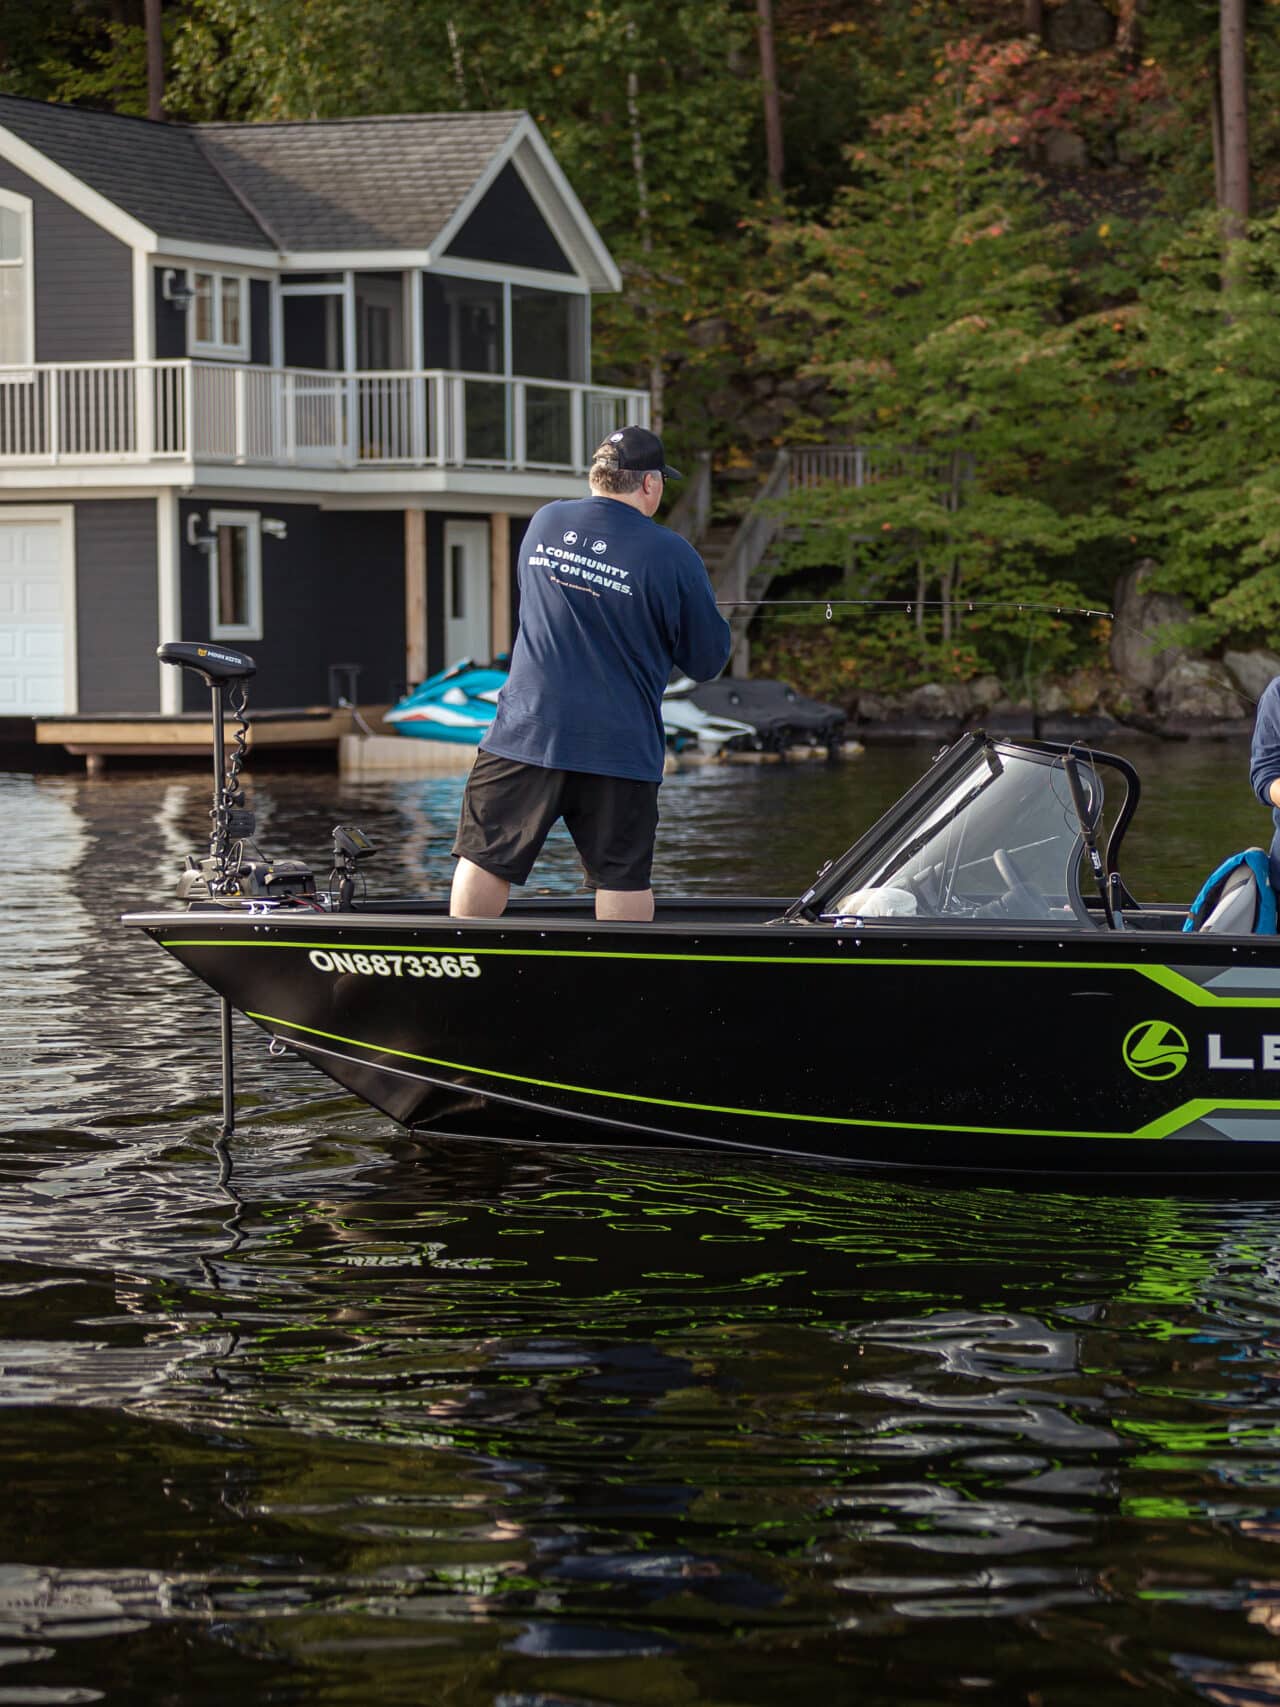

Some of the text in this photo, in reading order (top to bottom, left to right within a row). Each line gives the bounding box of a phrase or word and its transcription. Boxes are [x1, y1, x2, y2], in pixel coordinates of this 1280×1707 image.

[536, 543, 630, 579] A COMMUNITY
[560, 564, 580, 577] ON
[581, 570, 633, 596] WAVES.
[308, 950, 482, 978] ON8873365
